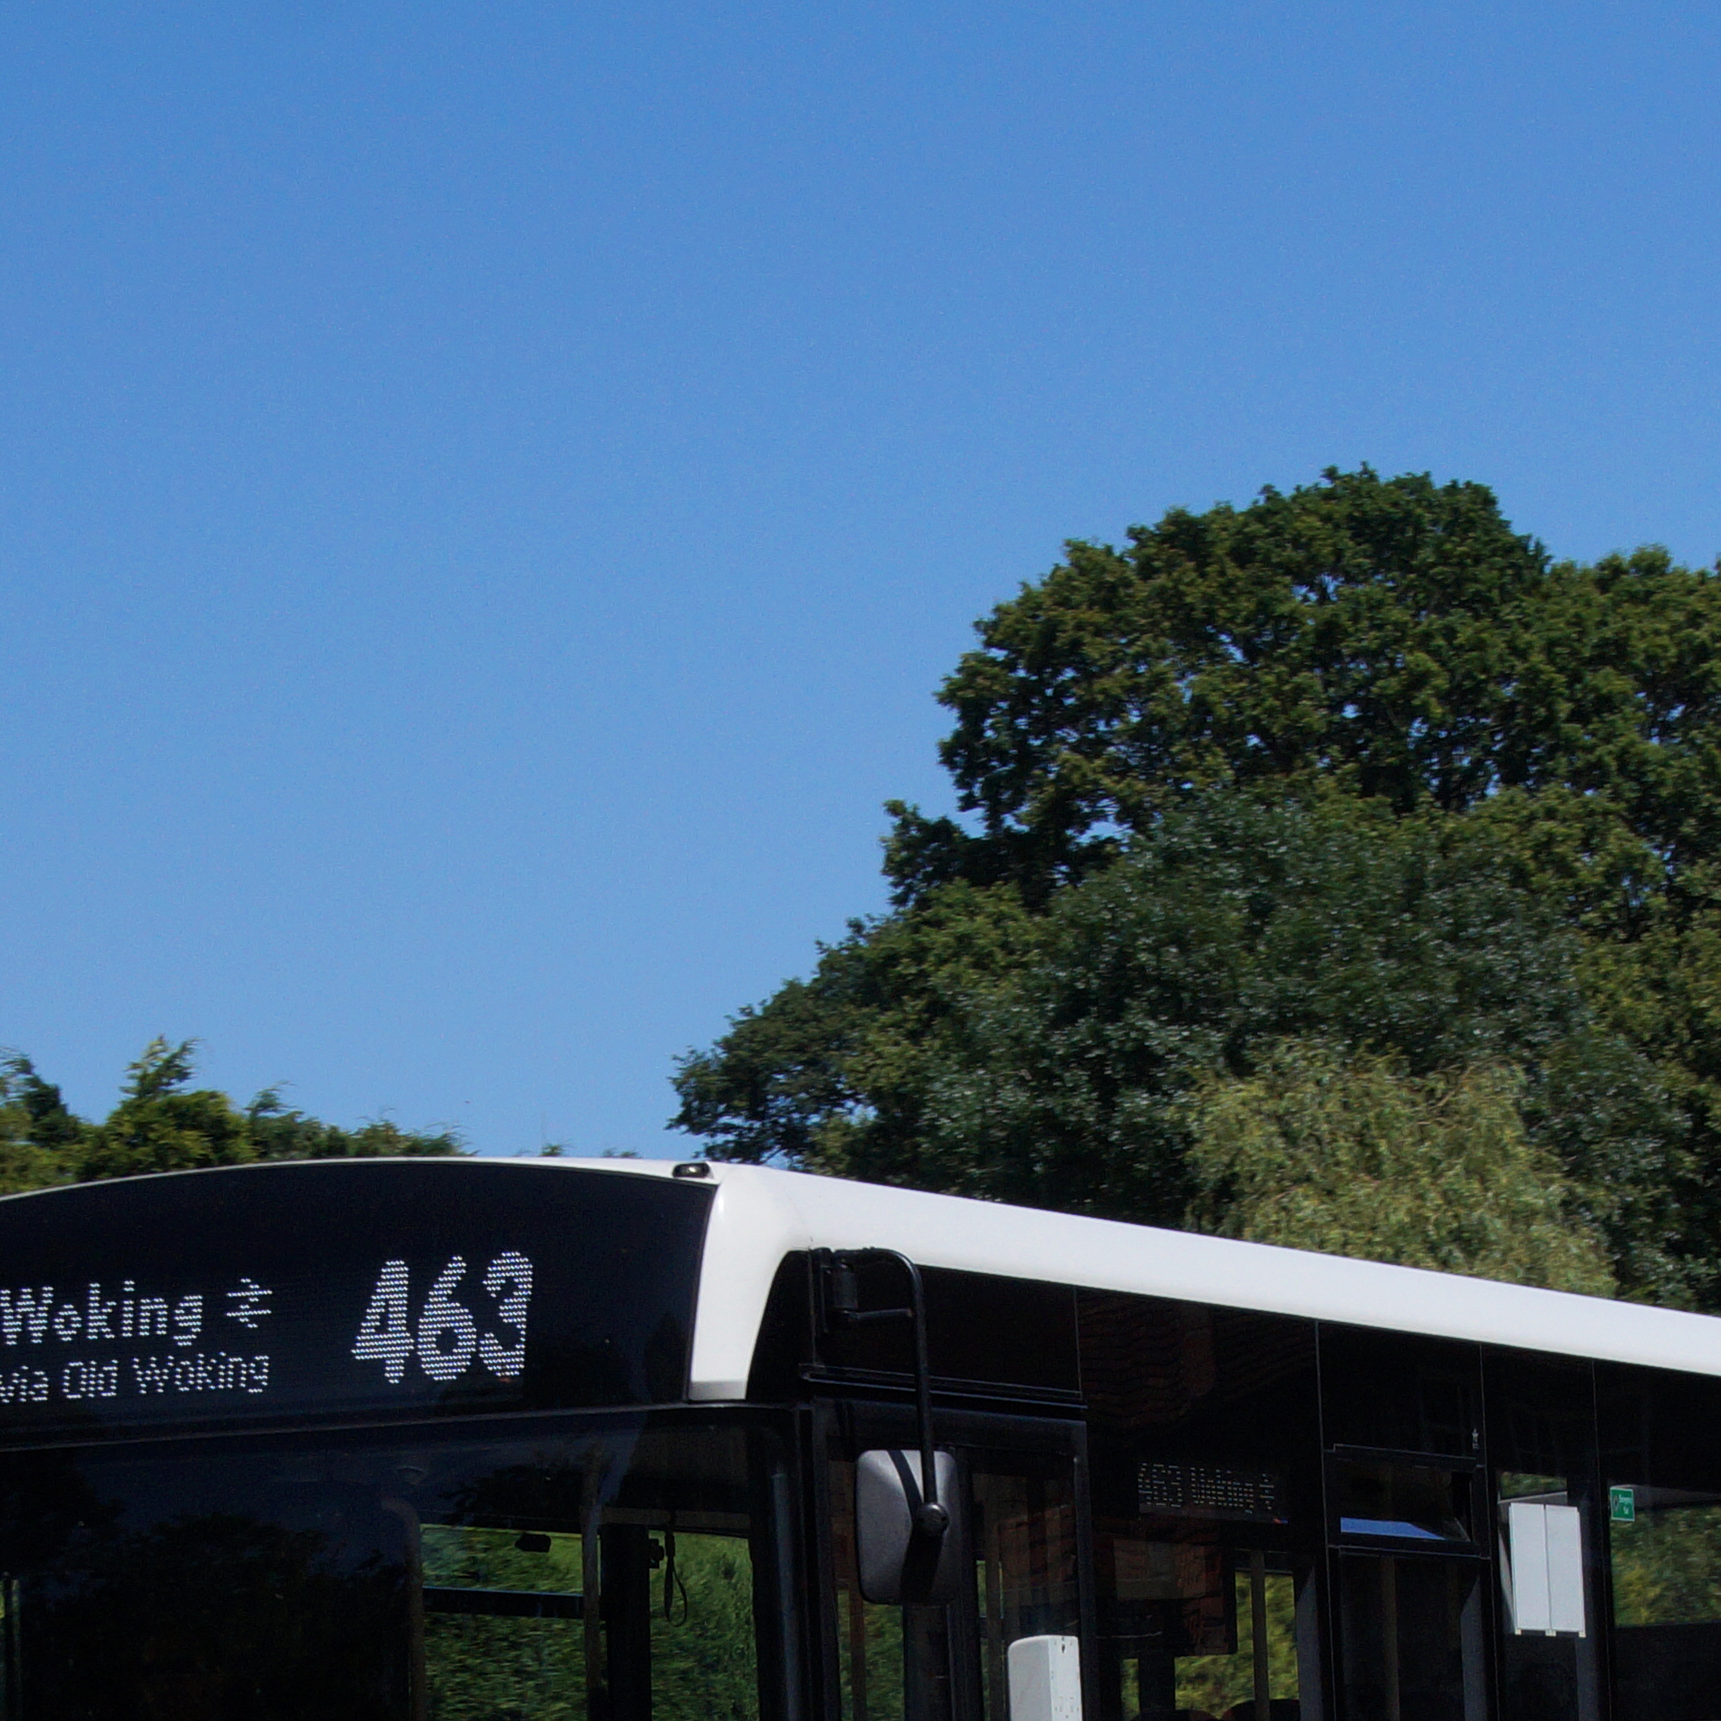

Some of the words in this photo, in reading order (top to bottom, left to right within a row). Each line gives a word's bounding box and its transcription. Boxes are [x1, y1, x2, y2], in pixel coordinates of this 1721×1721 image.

[351, 1251, 533, 1384] 463
[62, 1360, 118, 1399] Old
[133, 1352, 269, 1395] Woking
[1138, 1463, 1182, 1507] 463
